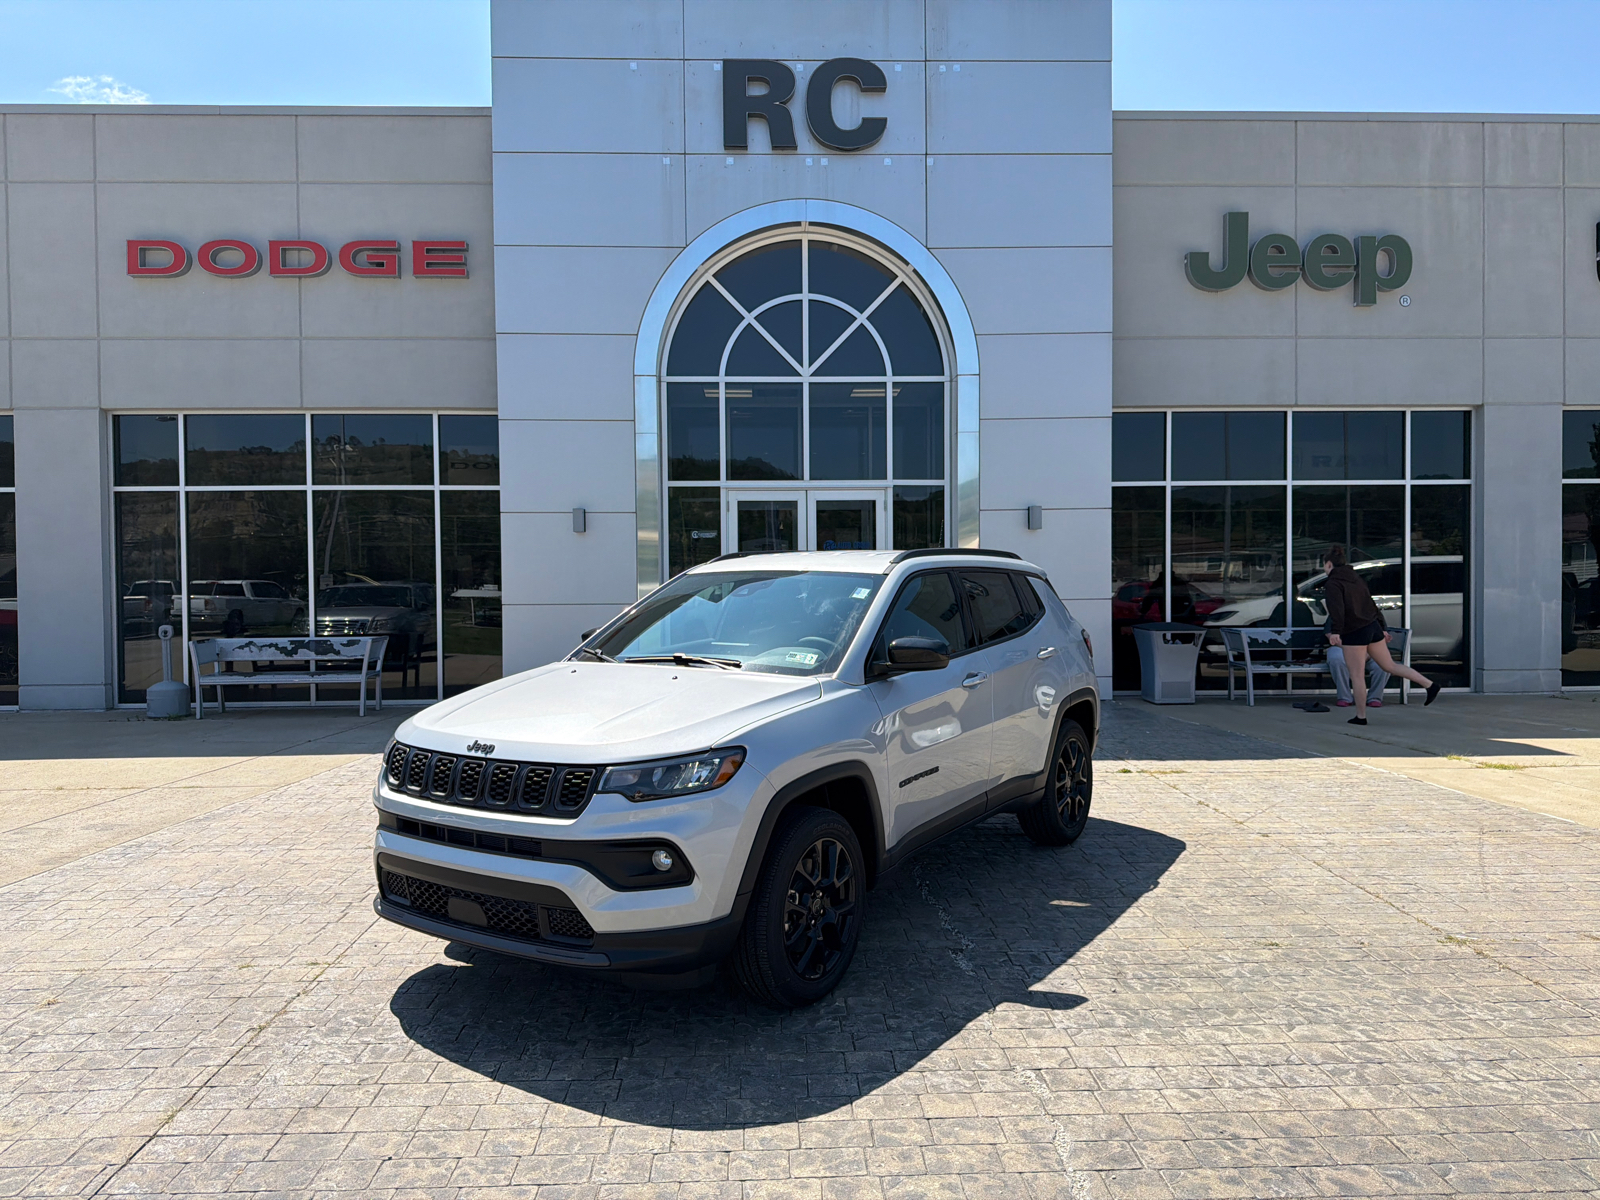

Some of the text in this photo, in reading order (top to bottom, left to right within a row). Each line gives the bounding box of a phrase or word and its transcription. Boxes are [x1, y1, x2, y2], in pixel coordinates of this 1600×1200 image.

[723, 57, 888, 153] RC
[126, 239, 469, 279] DODGE
[1184, 211, 1413, 307] Jeep
[467, 739, 496, 756] Jeep
